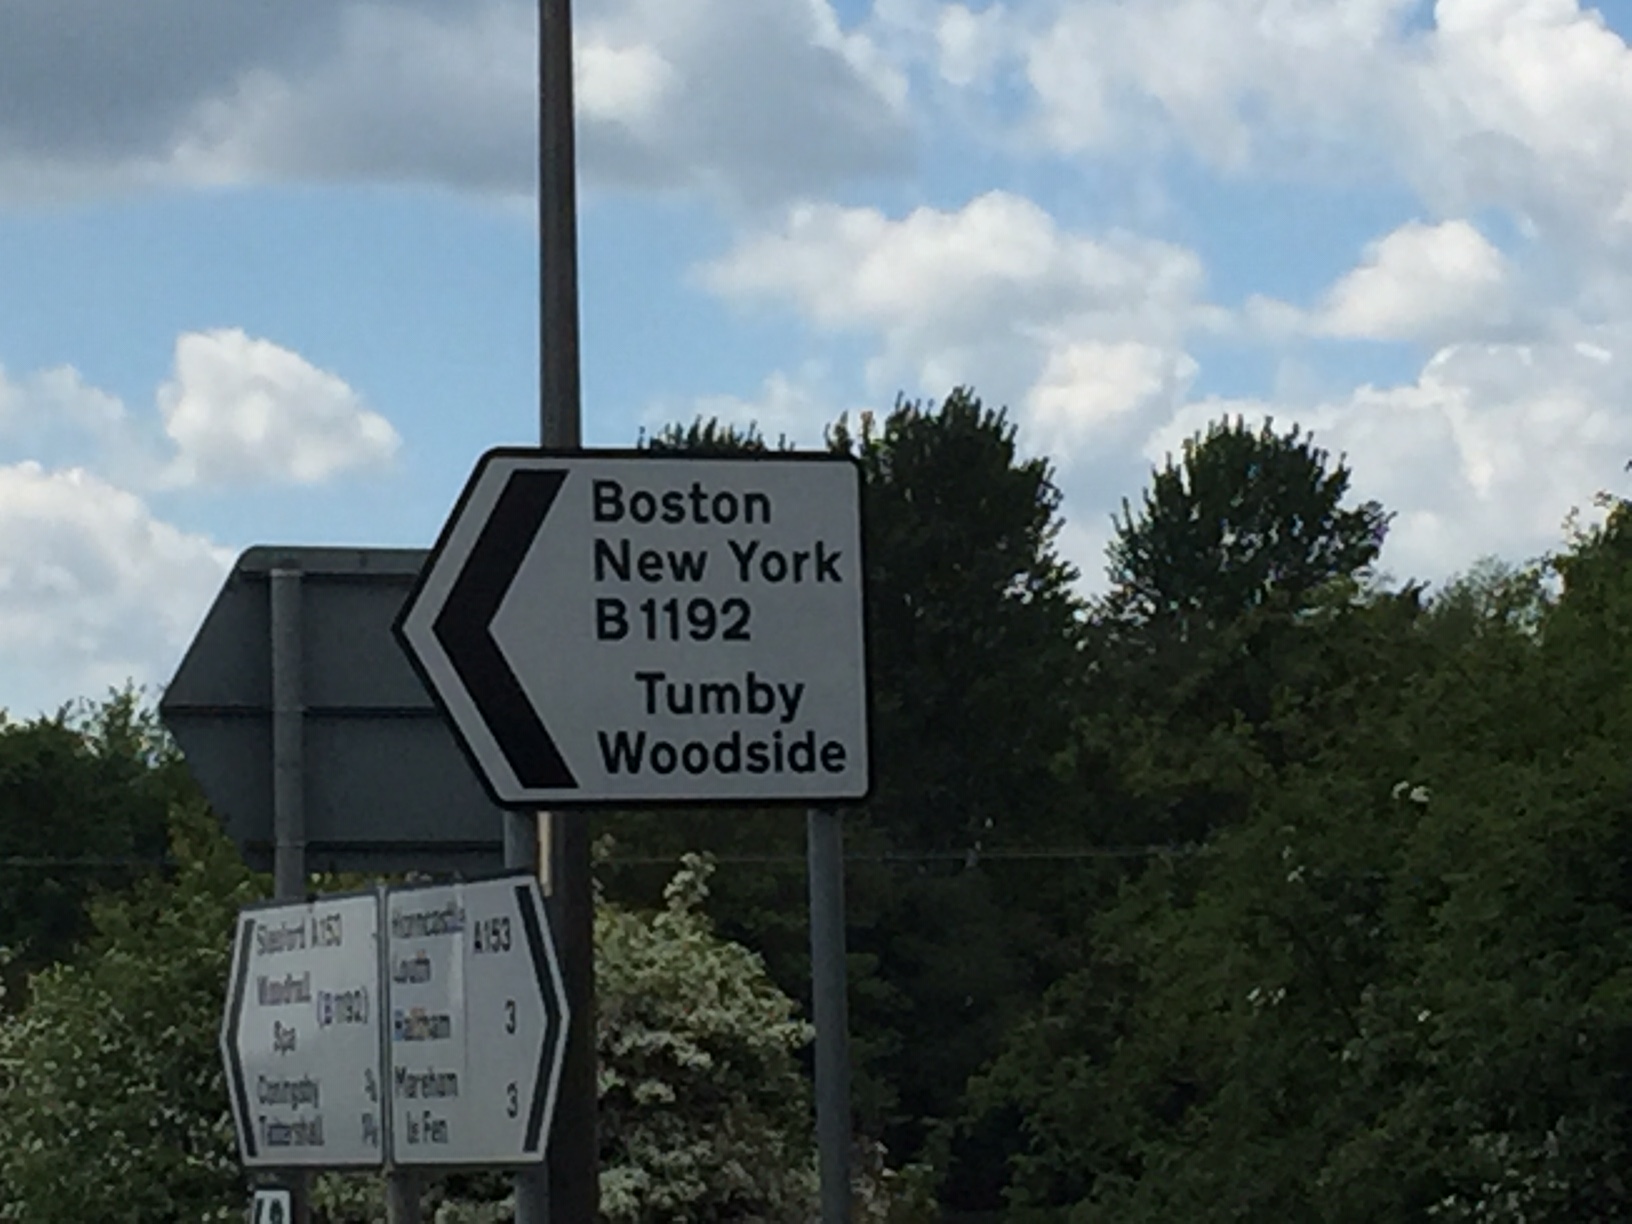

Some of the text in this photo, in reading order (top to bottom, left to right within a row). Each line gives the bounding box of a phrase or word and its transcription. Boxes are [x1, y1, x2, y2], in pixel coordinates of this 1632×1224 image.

[593, 479, 772, 524] Boston
[593, 538, 843, 583] New York
[635, 671, 805, 722] Tumby
[597, 731, 848, 775] Woodside
[474, 917, 511, 954] A153
[505, 999, 516, 1034] 3
[507, 1082, 518, 1118] 3
